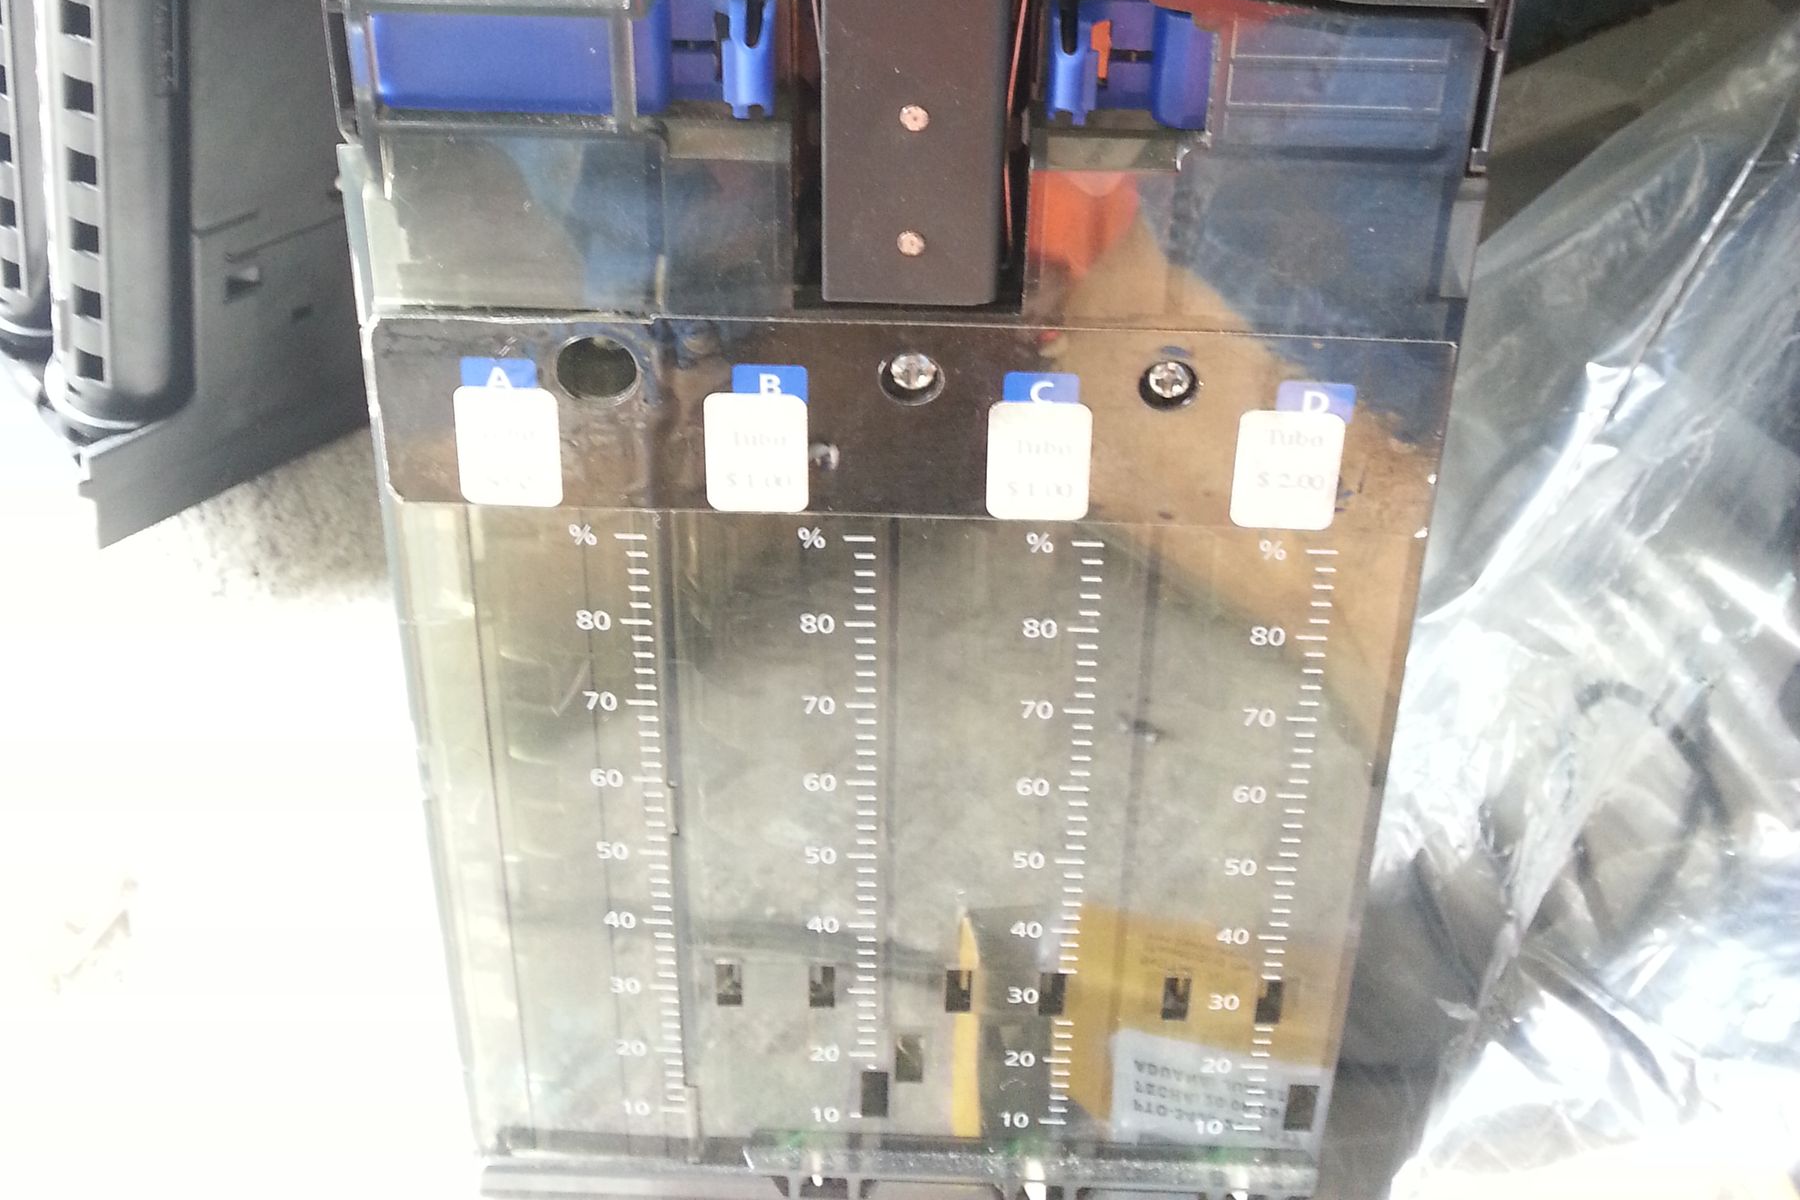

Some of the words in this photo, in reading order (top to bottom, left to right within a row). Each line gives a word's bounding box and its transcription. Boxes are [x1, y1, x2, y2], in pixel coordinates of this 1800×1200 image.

[758, 373, 782, 397] B
[1302, 390, 1330, 415] D
[575, 609, 612, 631] 80
[799, 613, 836, 634] 80
[1022, 618, 1058, 639] 80
[1249, 626, 1286, 646] 80
[582, 690, 618, 711] 70
[801, 695, 837, 716] 70
[1020, 700, 1054, 720] 70
[1242, 708, 1276, 727] 70
[590, 768, 624, 788] 60
[802, 772, 837, 792] 60
[1015, 777, 1050, 797] 60
[1232, 785, 1267, 804] 60
[596, 841, 629, 860] 50
[803, 846, 838, 865] 50
[1012, 851, 1046, 870] 50
[1224, 858, 1258, 877] 50
[603, 911, 637, 930] 40
[806, 916, 840, 935] 40
[1010, 921, 1043, 940] 40
[1216, 928, 1250, 946] 40
[609, 977, 642, 995] 30
[1007, 987, 1040, 1005] 30
[1208, 994, 1240, 1011] 30
[615, 1040, 647, 1057] 20
[809, 1045, 840, 1063] 20
[1004, 1051, 1036, 1067] 20
[1201, 1057, 1233, 1074] 20
[623, 1100, 650, 1117] 10
[811, 1107, 840, 1123] 10
[1001, 1111, 1030, 1129] 10
[1195, 1119, 1224, 1135] 10
